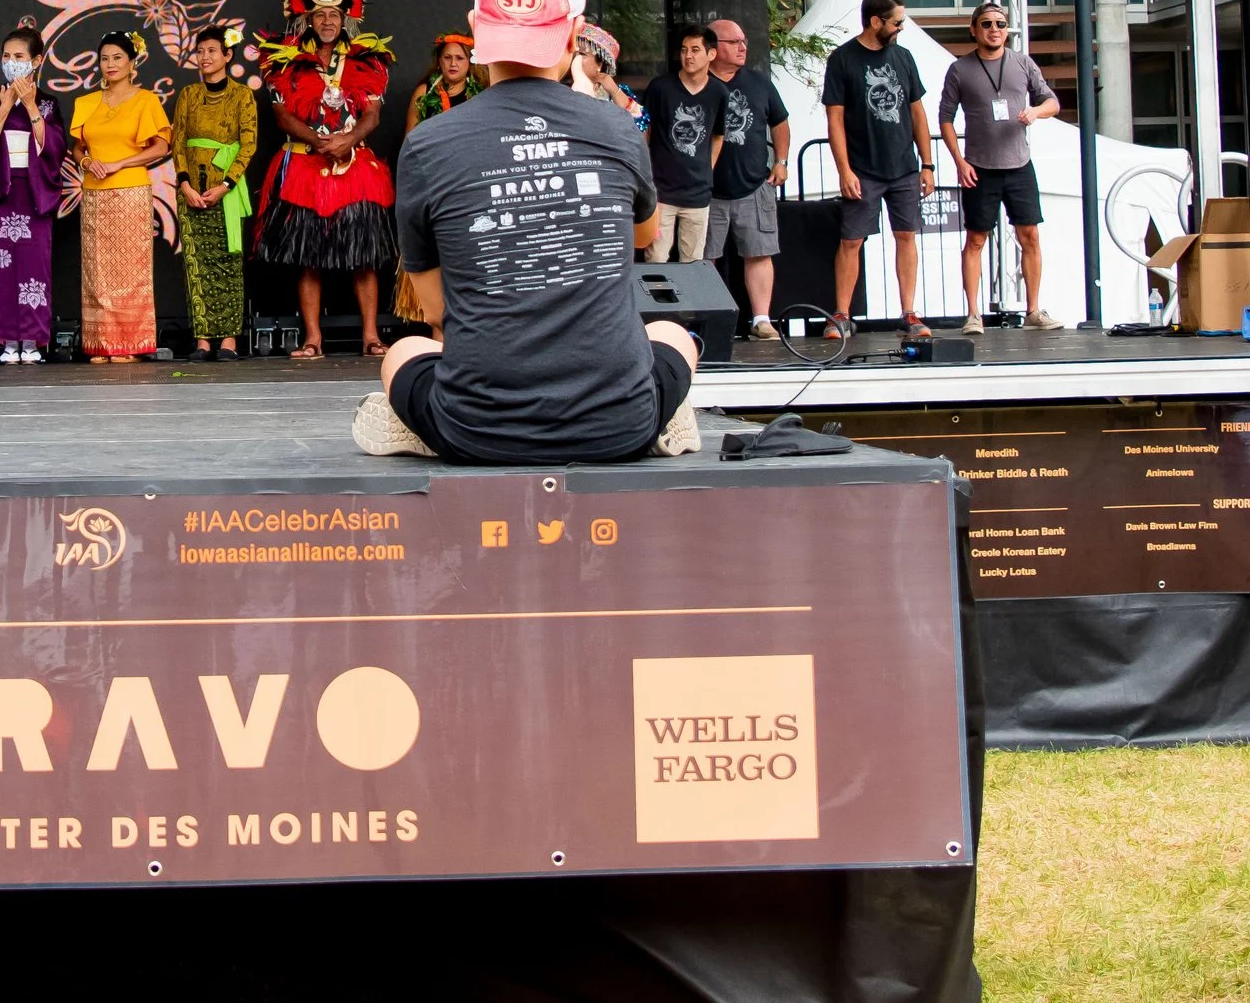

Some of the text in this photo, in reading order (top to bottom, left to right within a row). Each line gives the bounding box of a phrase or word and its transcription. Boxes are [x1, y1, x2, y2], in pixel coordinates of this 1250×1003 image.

[512, 141, 570, 162] STAFF
[481, 168, 508, 177] THANK
[490, 176, 565, 198] BRAVO
[975, 447, 1019, 459] Meredith
[1124, 444, 1220, 455] Des Moines University
[958, 467, 1069, 479] Drinker Biddle & Reath
[183, 507, 399, 534] #IAACelebrAsian
[1125, 521, 1219, 532] Davis Brown Law Firm
[985, 528, 1014, 538] Home
[1015, 527, 1040, 537] Loan
[1041, 526, 1066, 536] Bank
[179, 542, 405, 564] iowaasianalliance.com
[971, 546, 1067, 558] Creole Korean Eatery
[1146, 542, 1197, 552] Broadlawns
[979, 567, 1037, 578] Lucky Lotus
[644, 713, 799, 744] WELLS
[652, 752, 798, 783] FARGO
[111, 814, 200, 849] DES
[227, 809, 420, 847] MOINES
